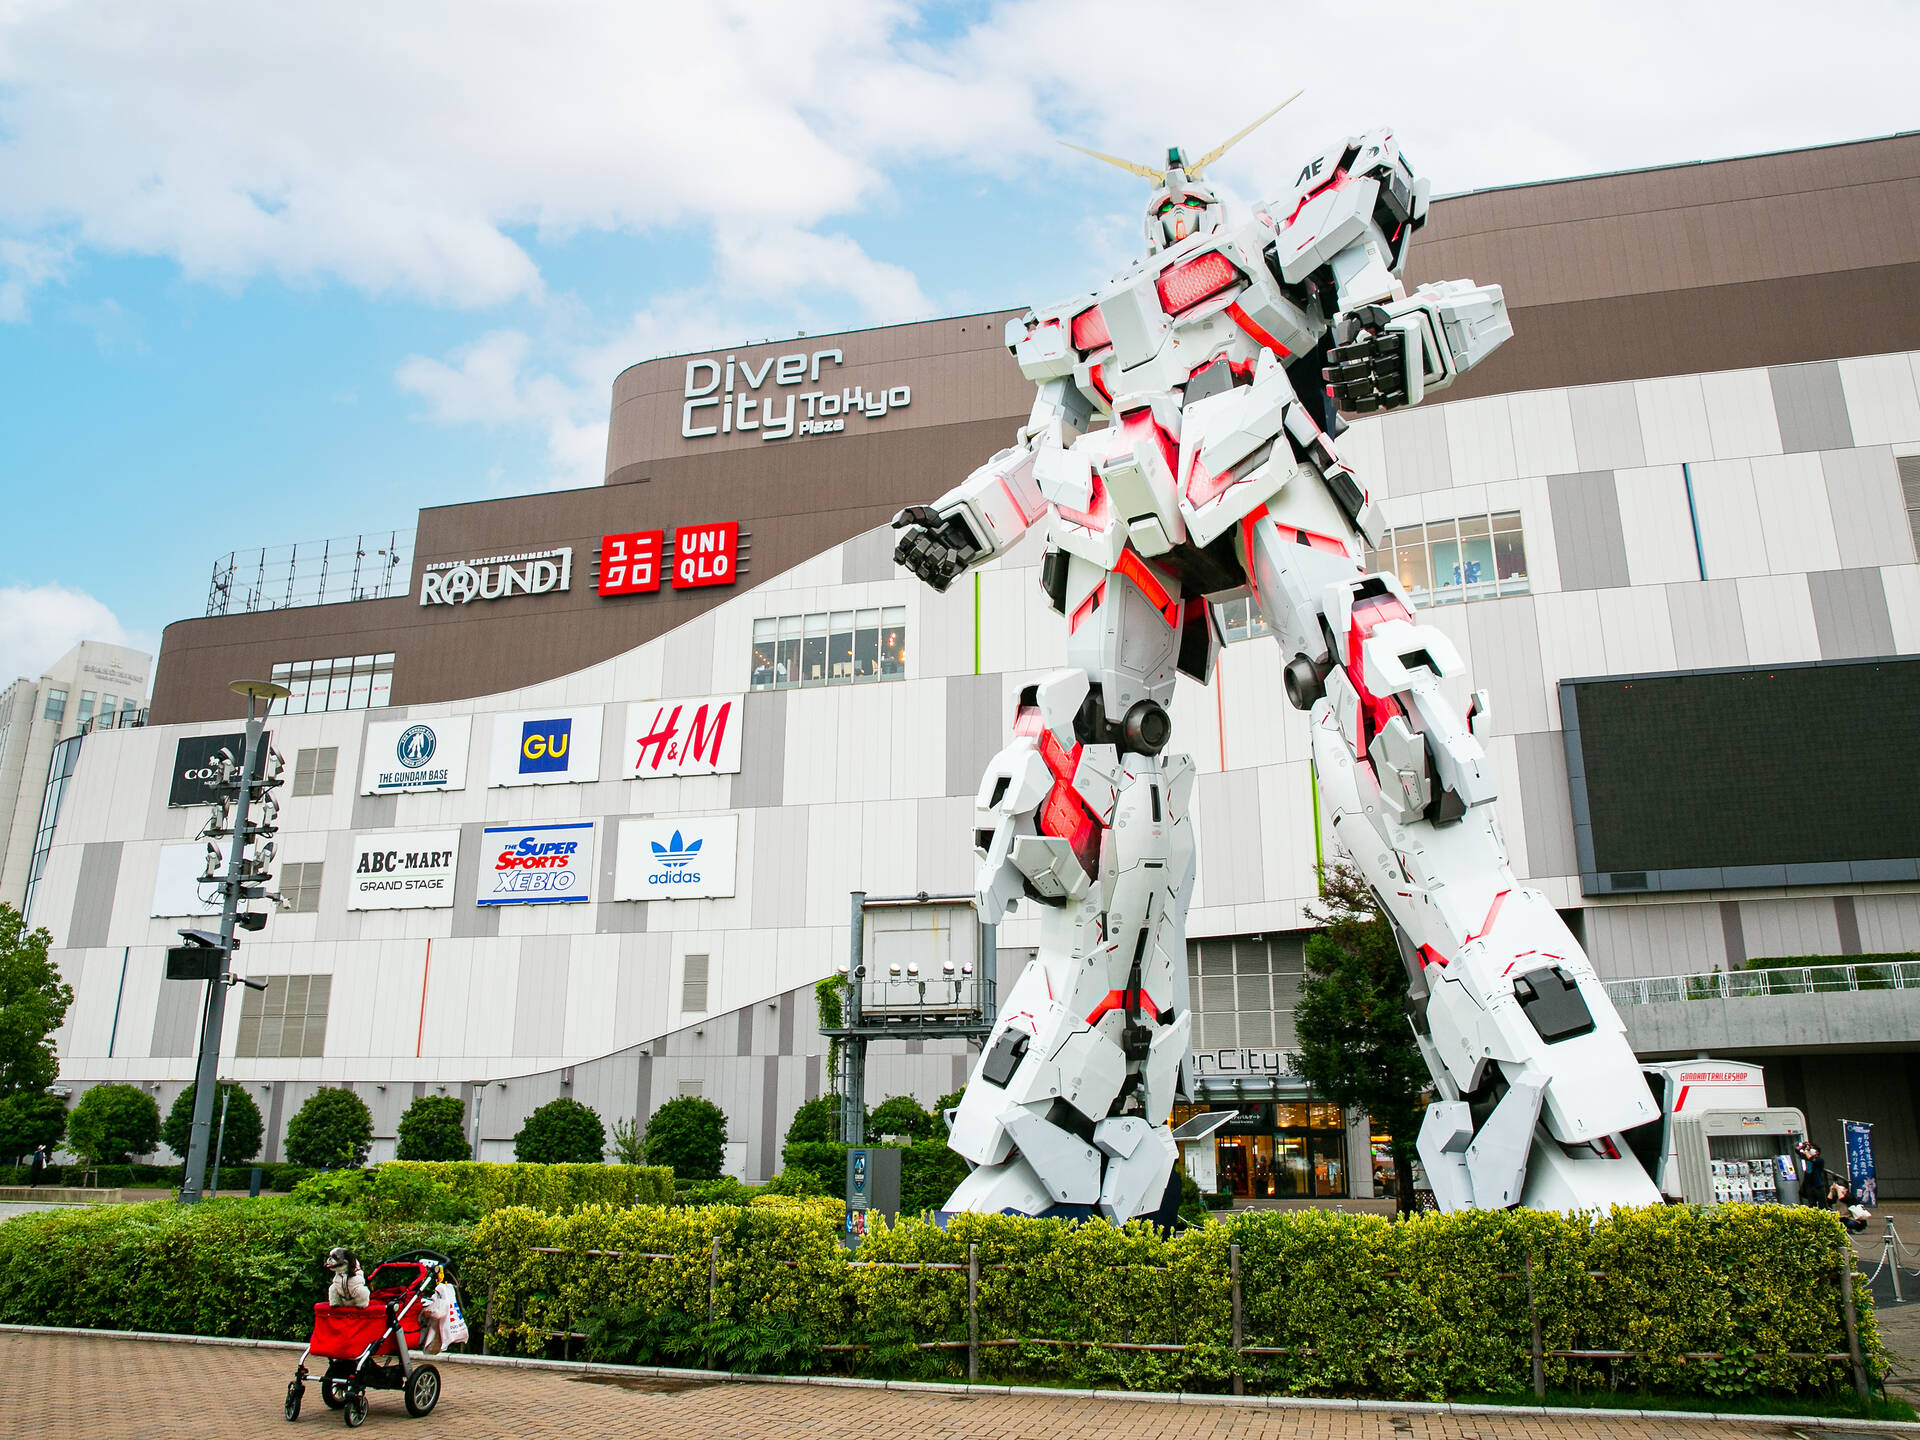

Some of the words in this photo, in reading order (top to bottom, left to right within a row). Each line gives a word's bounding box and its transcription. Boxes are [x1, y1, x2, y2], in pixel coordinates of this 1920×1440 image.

[684, 348, 843, 398] Diver
[681, 391, 796, 440] City
[799, 385, 911, 418] Tokyo
[798, 418, 845, 436] Plaza
[681, 529, 726, 555] UNI
[425, 560, 466, 571] SPORTS
[469, 550, 558, 566] ENTERTAINMENT
[680, 554, 728, 583] QLO
[522, 733, 568, 760] GU
[635, 701, 732, 771] H&M
[379, 773, 393, 783] THE
[394, 771, 427, 782] GUNDAM
[428, 769, 448, 780] BASE
[515, 836, 578, 857] SUPER
[356, 850, 453, 874] ABC-MART
[494, 850, 570, 871] SPORTS
[359, 880, 403, 892] GRAND
[404, 878, 445, 890] STAGE
[493, 869, 576, 893] XEBIO
[648, 869, 701, 885] adidas
